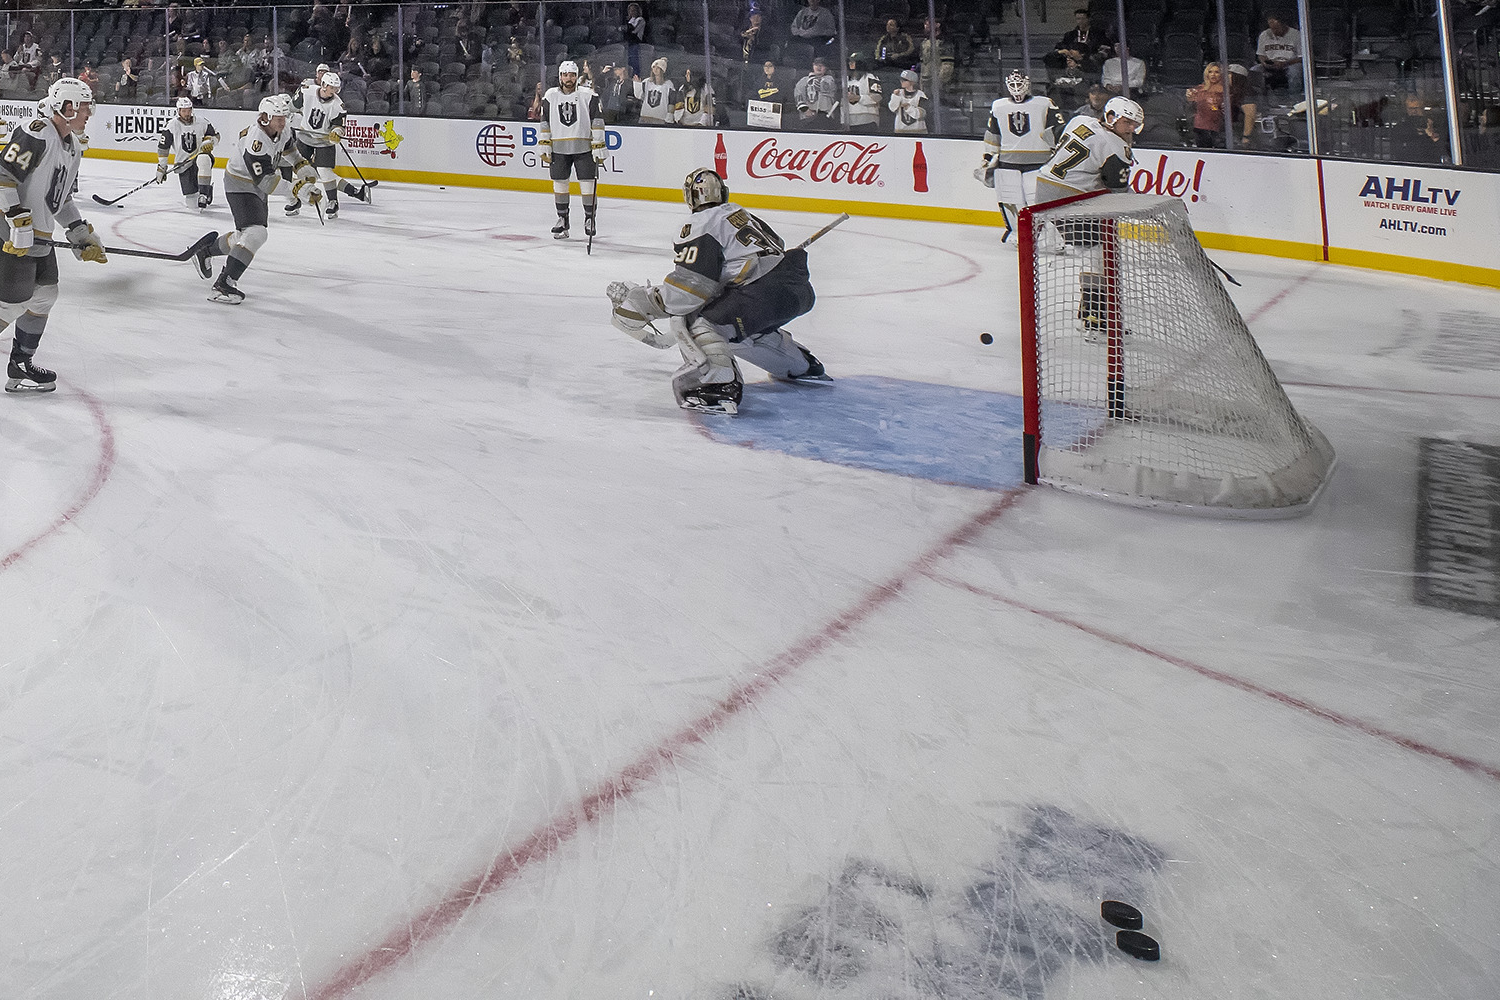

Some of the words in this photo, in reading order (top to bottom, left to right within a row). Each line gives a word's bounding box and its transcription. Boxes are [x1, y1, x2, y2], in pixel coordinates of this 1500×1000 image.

[130, 108, 155, 116] HOME
[114, 114, 172, 139] HENDE
[346, 126, 379, 139] HICKEN
[3, 142, 34, 171] 64
[746, 136, 888, 188] Coca-Cola
[251, 160, 264, 177] 6
[1131, 154, 1206, 203] ole!
[1358, 174, 1462, 206] AHLTV
[1363, 200, 1390, 210] WATCH
[1391, 204, 1416, 213] EVERY
[1416, 205, 1438, 215] GAME
[1440, 208, 1457, 217] LIVE
[1379, 218, 1447, 237] AHLTV.com
